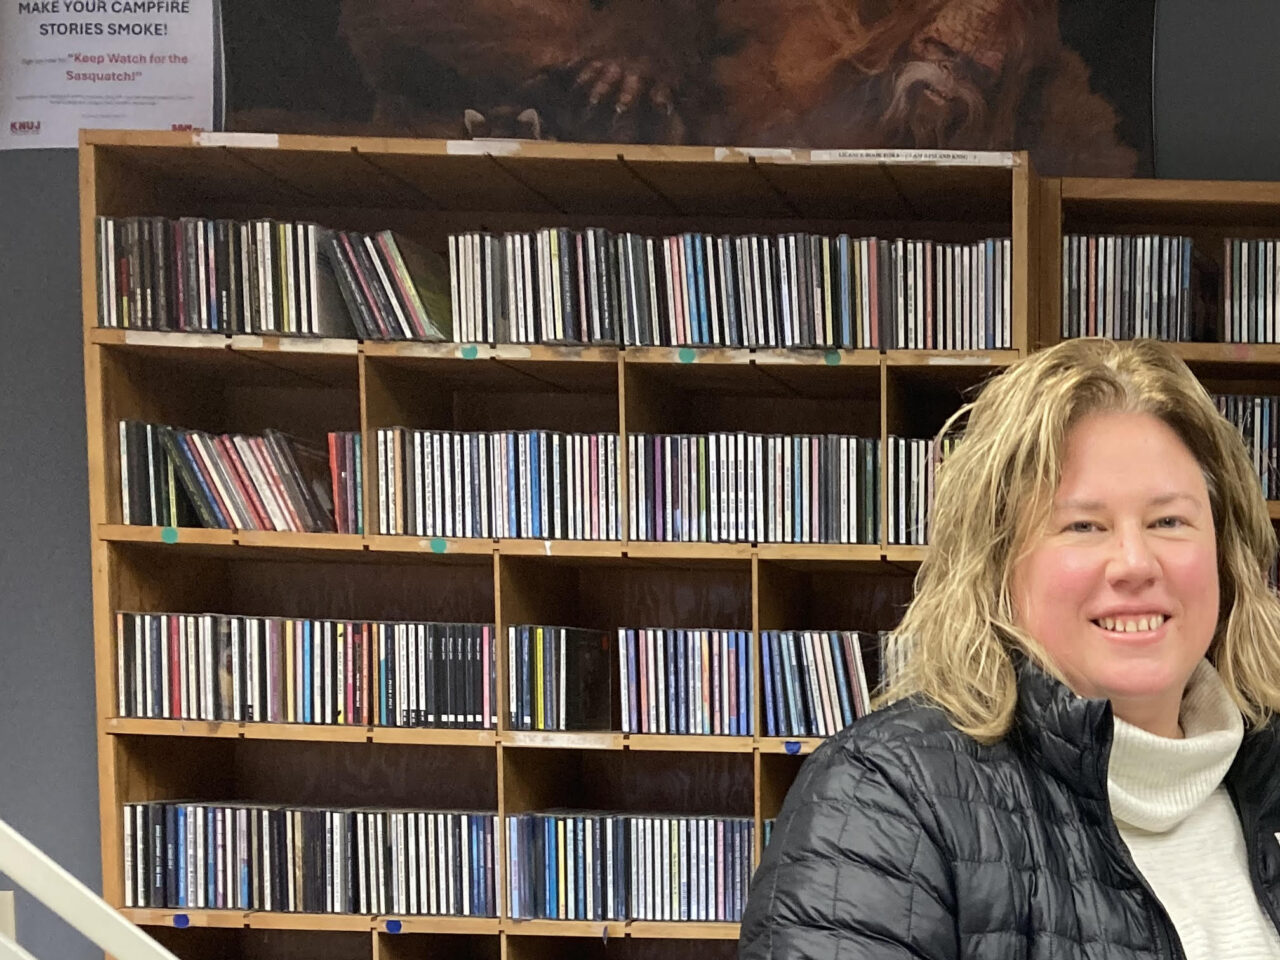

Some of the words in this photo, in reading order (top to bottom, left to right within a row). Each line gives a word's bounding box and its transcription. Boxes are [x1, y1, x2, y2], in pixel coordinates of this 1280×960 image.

[18, 1, 60, 14] MAKE
[63, 0, 107, 13] YOUR
[111, 0, 190, 13] CAMPFIRE
[40, 23, 103, 36] STORIES
[107, 23, 168, 36] SMOKE!
[107, 53, 147, 64] Watch
[149, 53, 166, 64] for
[168, 53, 189, 65] the
[10, 121, 41, 131] KNUJ
